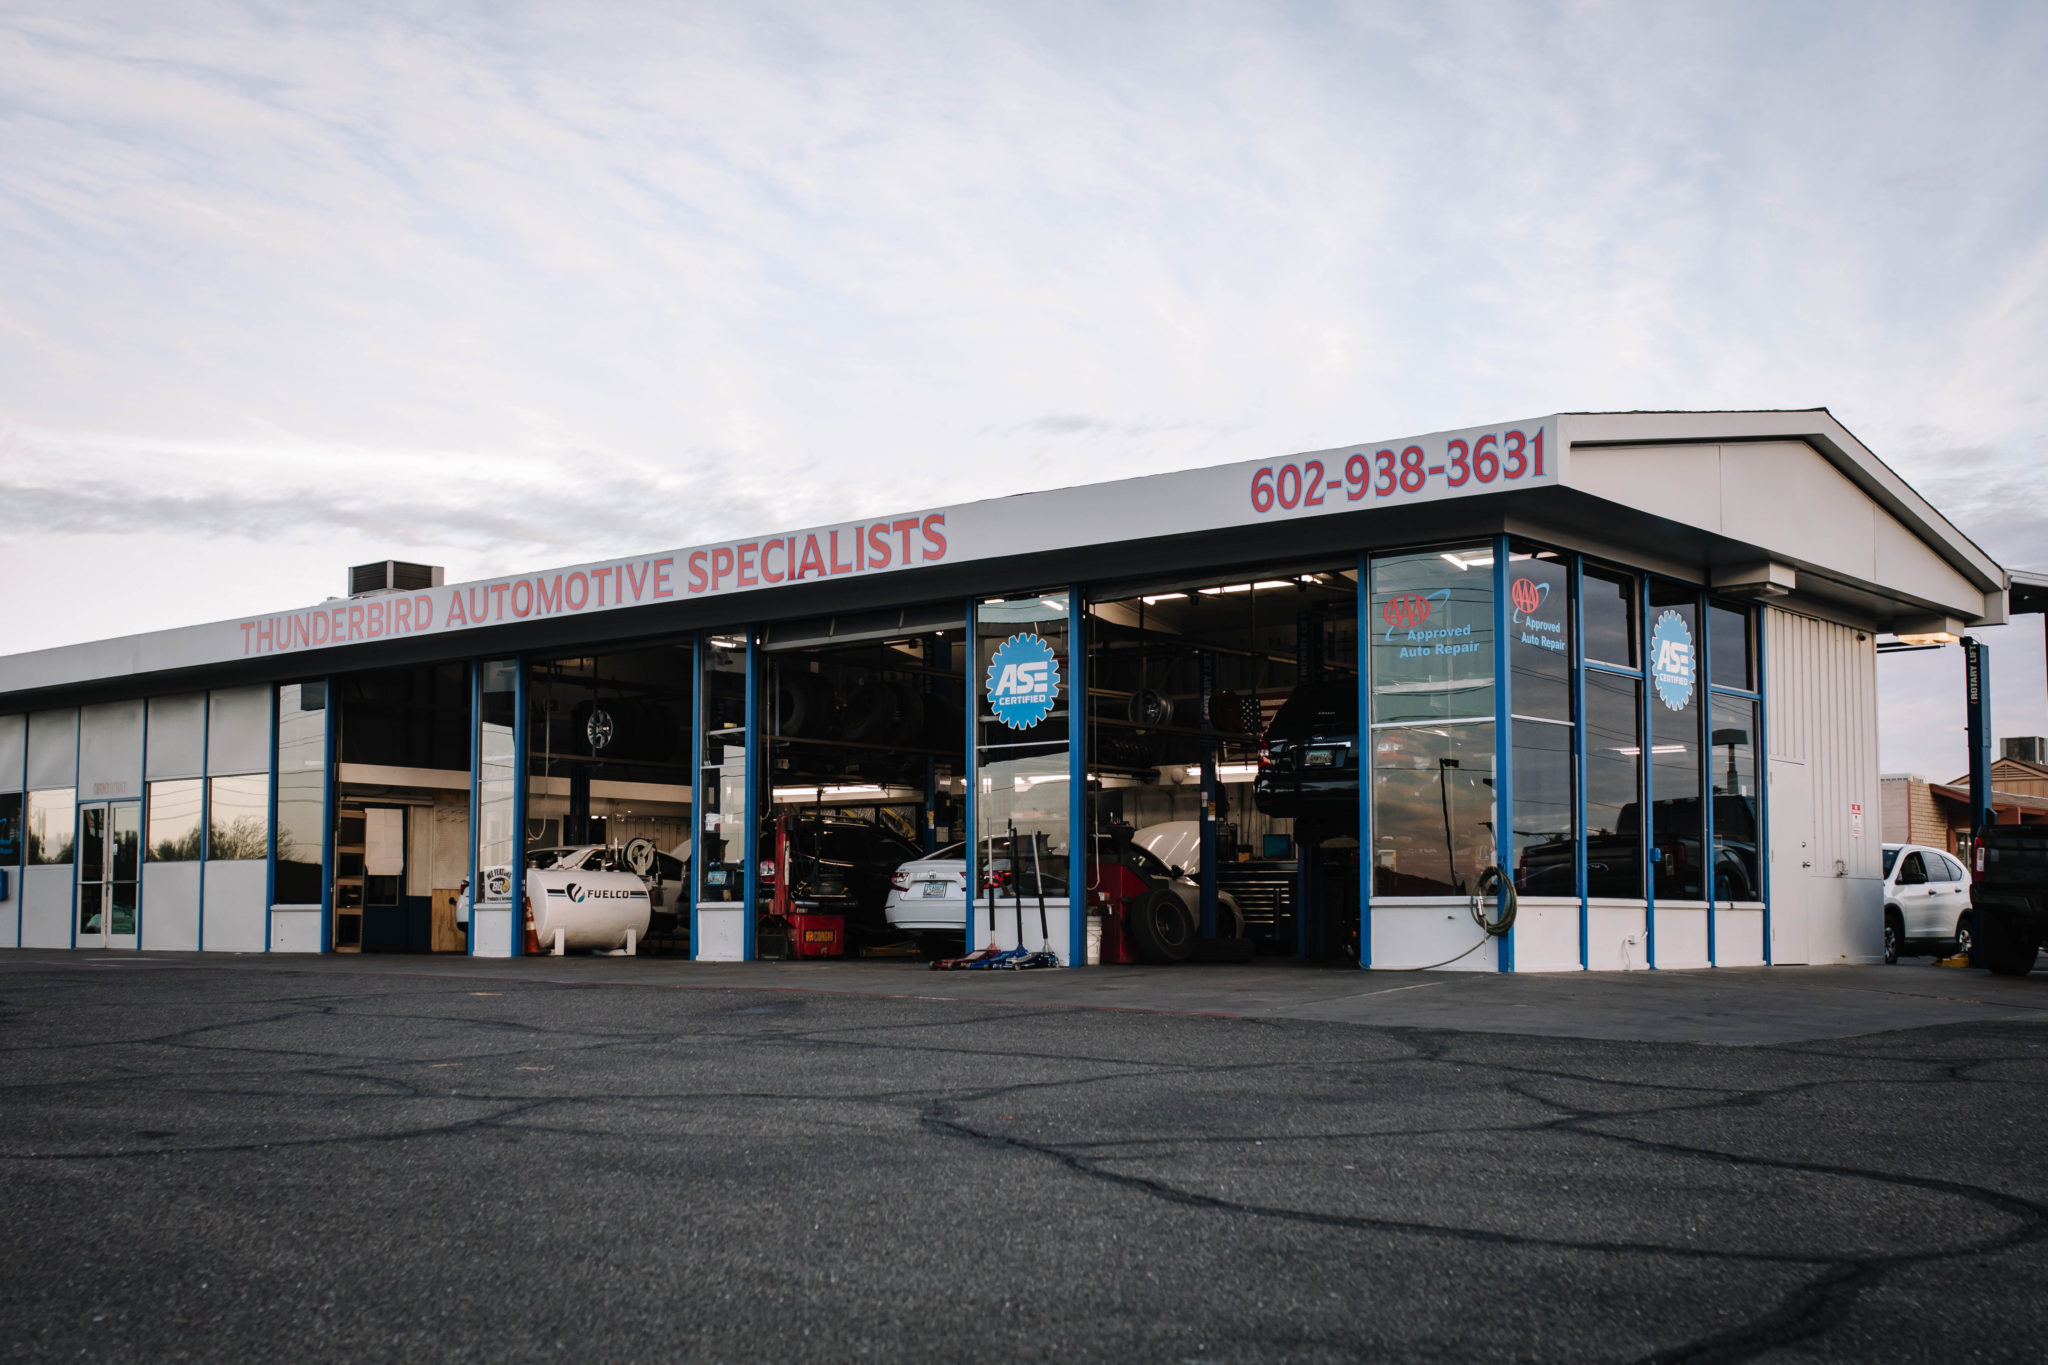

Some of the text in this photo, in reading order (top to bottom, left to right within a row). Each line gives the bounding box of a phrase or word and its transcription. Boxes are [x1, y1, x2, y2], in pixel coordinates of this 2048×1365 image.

[1250, 426, 1547, 513] 602-938-3631
[239, 511, 948, 656] THUNDERBIRD AUTOMOTIVE SPECIALISTS
[1407, 624, 1471, 642] Approved
[1526, 616, 1561, 633] Approved
[1400, 641, 1480, 658] Auto Repair
[1521, 631, 1566, 650] Auto Repair
[1657, 639, 1689, 676] ASE
[995, 661, 1048, 696] ASE
[1660, 673, 1688, 686] CERTIFIED
[1969, 645, 1978, 700] ROTARY LIFT
[999, 694, 1046, 705] CERTIFIED
[587, 889, 629, 899] FUELCO
